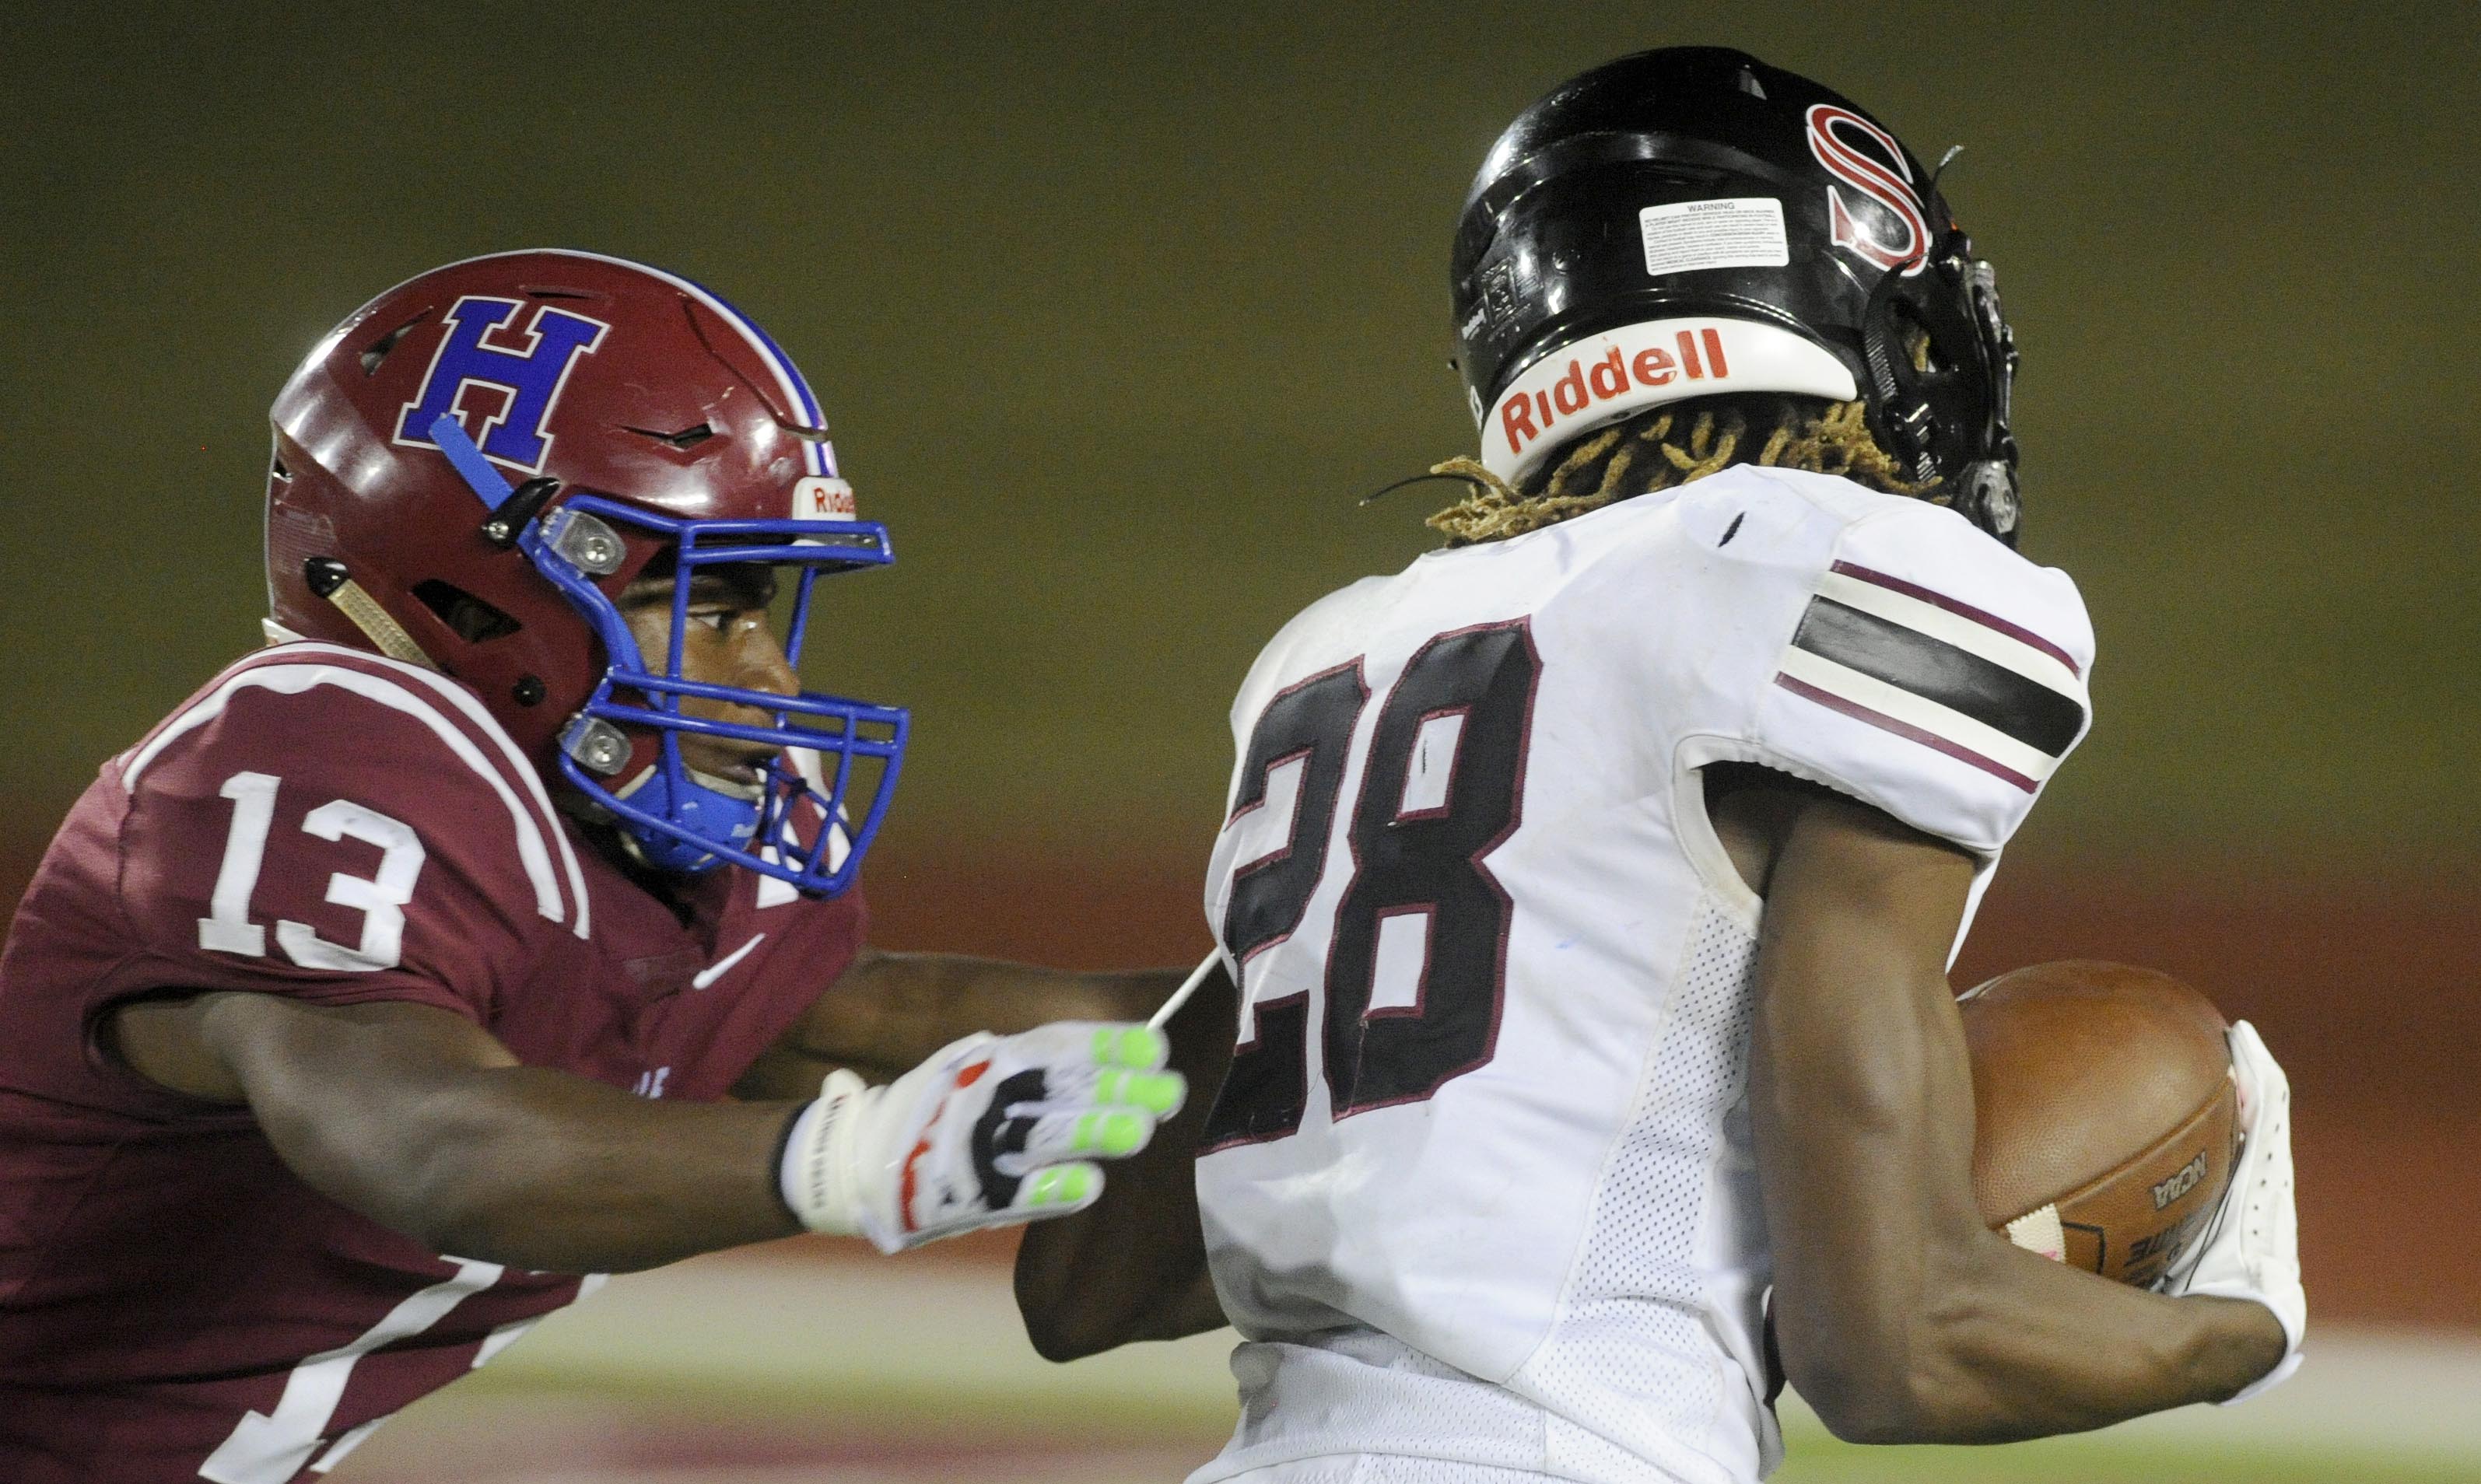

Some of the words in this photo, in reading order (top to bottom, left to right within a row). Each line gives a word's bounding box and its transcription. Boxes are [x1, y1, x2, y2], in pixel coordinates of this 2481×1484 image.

[1686, 201, 1736, 213] WARNING
[1805, 103, 1933, 278] S
[392, 295, 611, 475] H
[1500, 327, 1729, 455] Riddell
[198, 772, 426, 971] 13
[1195, 614, 1544, 1157] 28
[2149, 1148, 2208, 1211] NCAA
